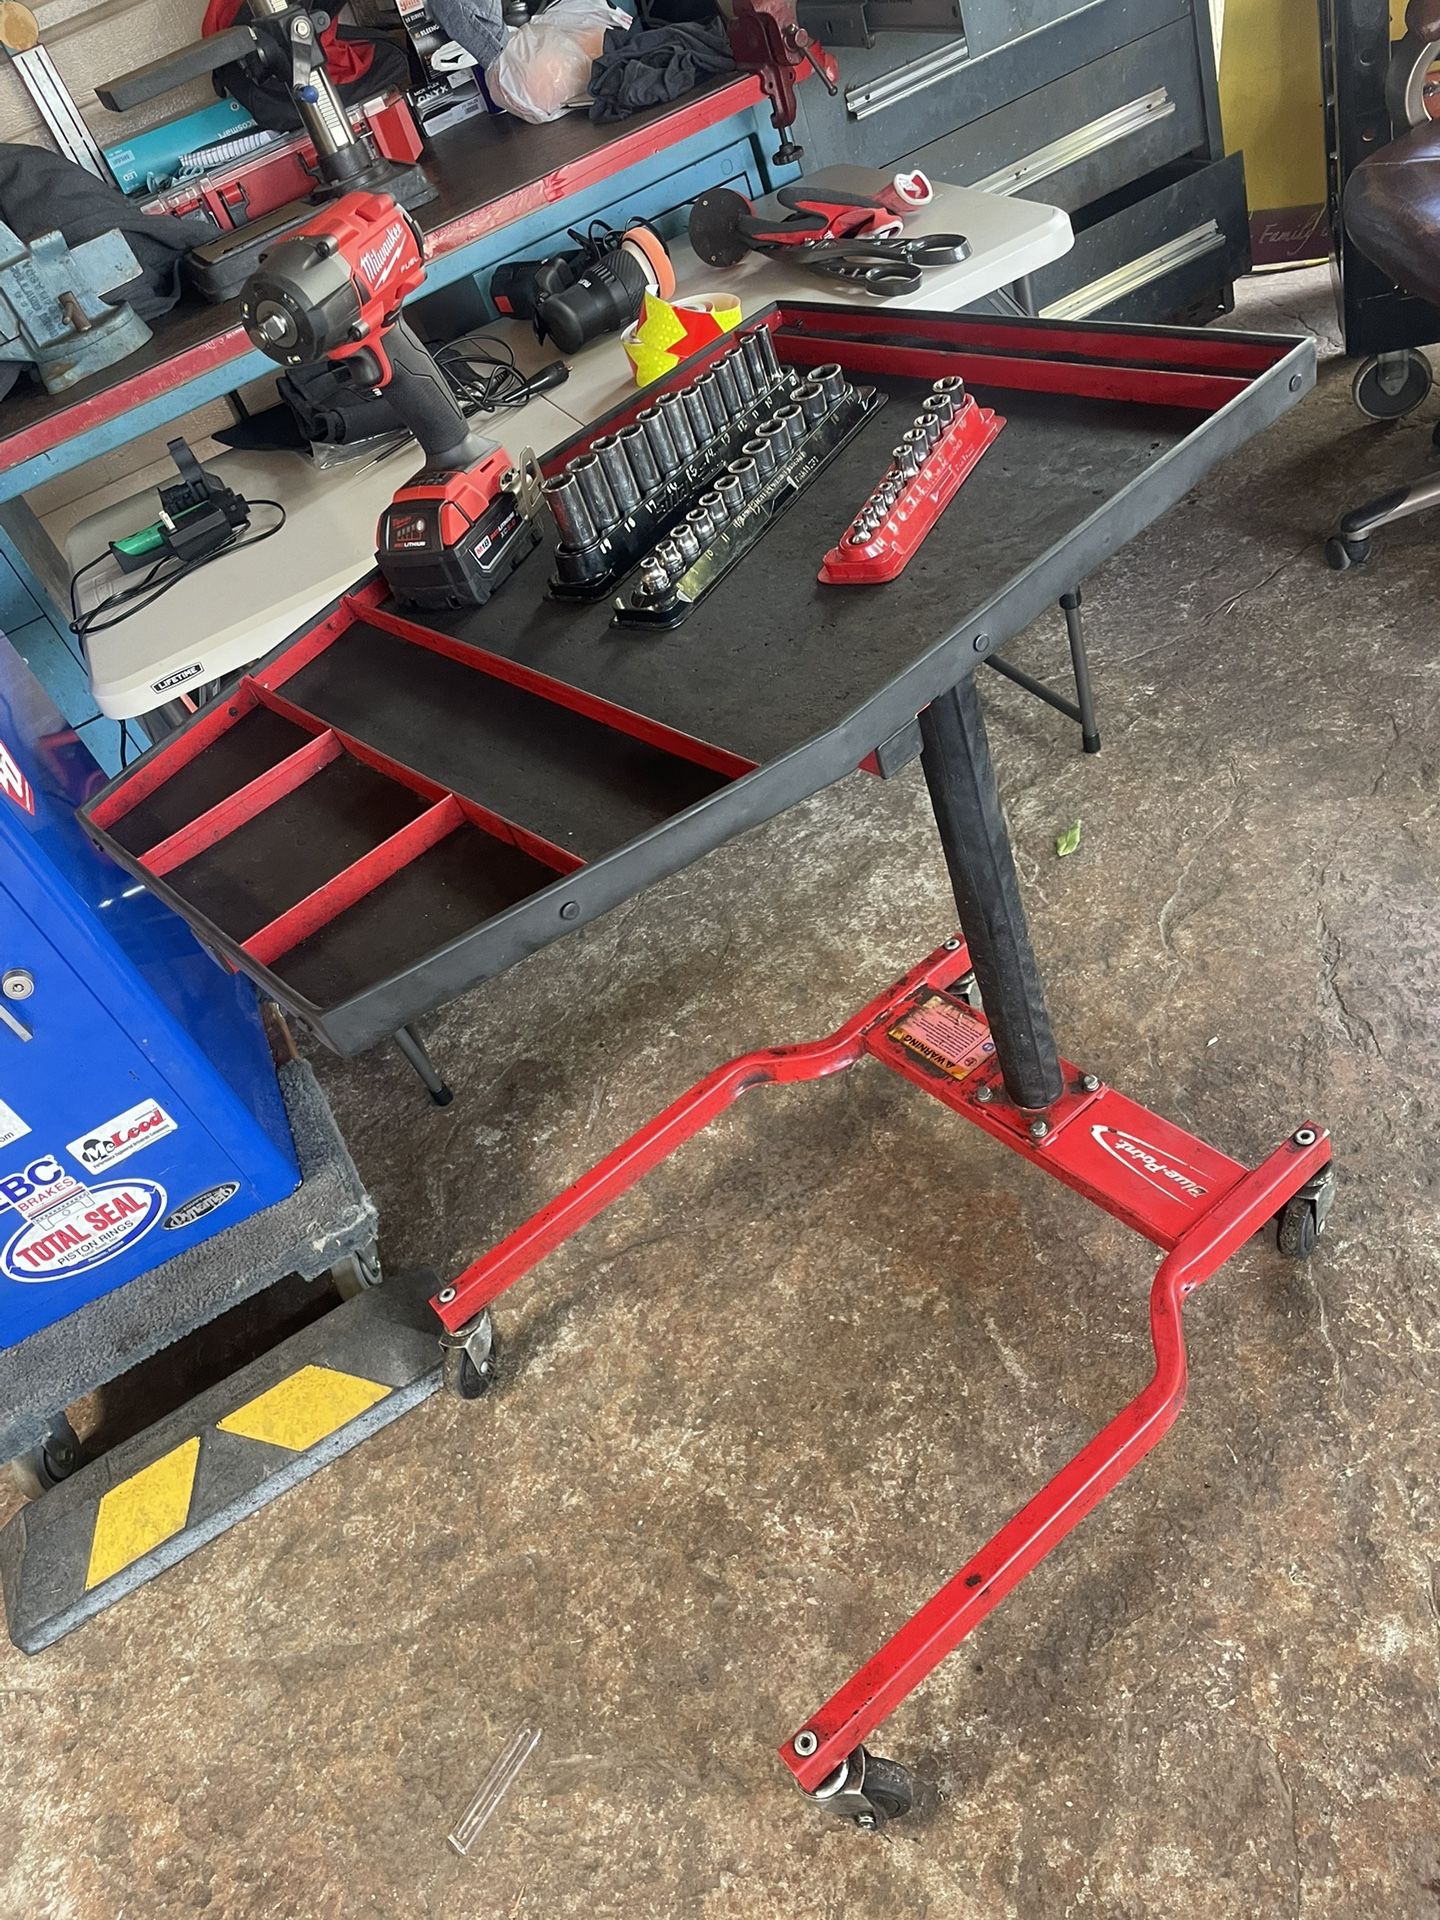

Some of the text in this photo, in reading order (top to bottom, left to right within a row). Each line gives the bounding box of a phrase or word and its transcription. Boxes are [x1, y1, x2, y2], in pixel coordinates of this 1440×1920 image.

[418, 85, 448, 101] ONYX
[123, 170, 138, 182] LED
[360, 223, 404, 284] Milwaukee
[401, 256, 419, 273] FUEL
[475, 536, 492, 557] M18
[158, 666, 198, 689] LIFETIME
[904, 1034, 946, 1065] WARNING
[84, 1109, 165, 1163] McLeod
[1115, 1139, 1208, 1198] Blue-Point
[0, 1160, 62, 1211] BC
[18, 1178, 73, 1211] BRAKES
[16, 1192, 147, 1267] TOTAL SEAL
[57, 1220, 134, 1266] PISTON RINGS
